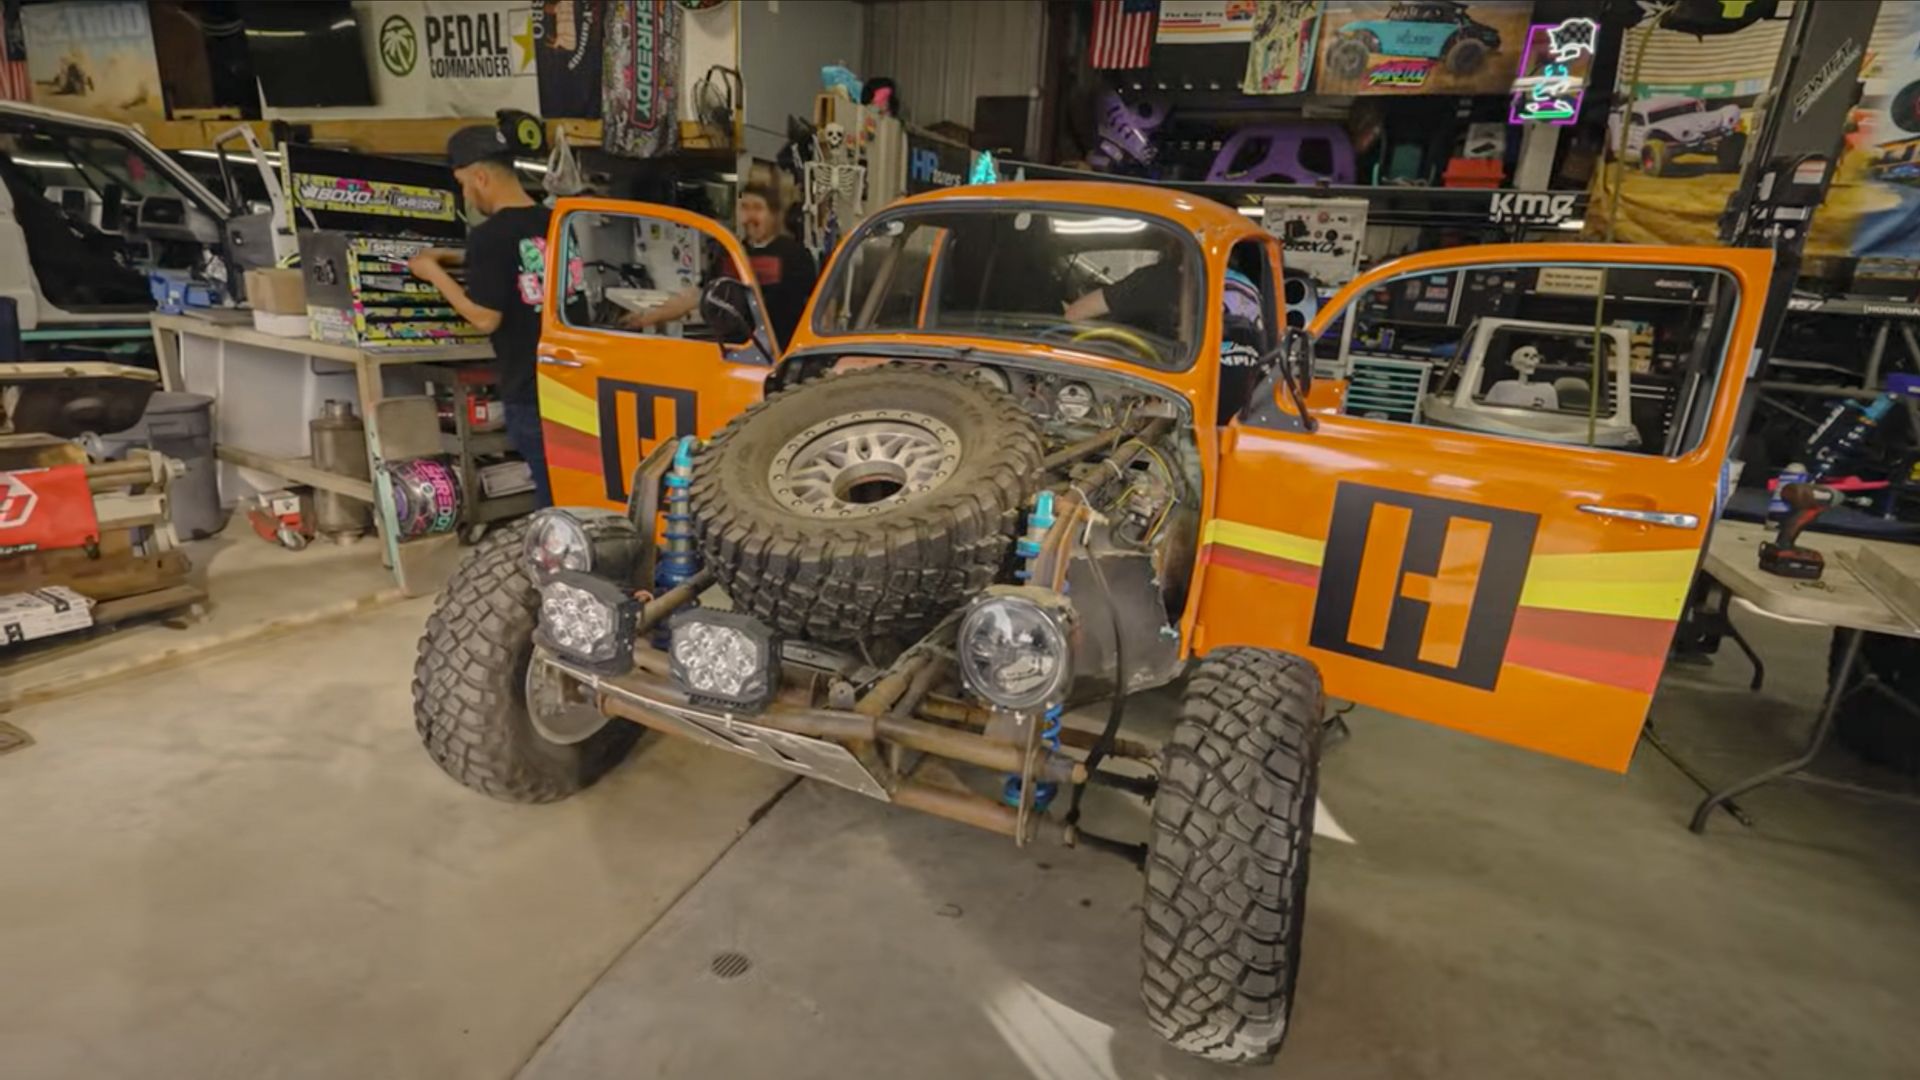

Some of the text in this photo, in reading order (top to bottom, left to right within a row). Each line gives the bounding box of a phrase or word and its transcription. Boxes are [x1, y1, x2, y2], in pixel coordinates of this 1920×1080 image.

[425, 12, 508, 57] PEDAL
[430, 56, 511, 79] COMMANDER
[316, 188, 371, 204] BOXO
